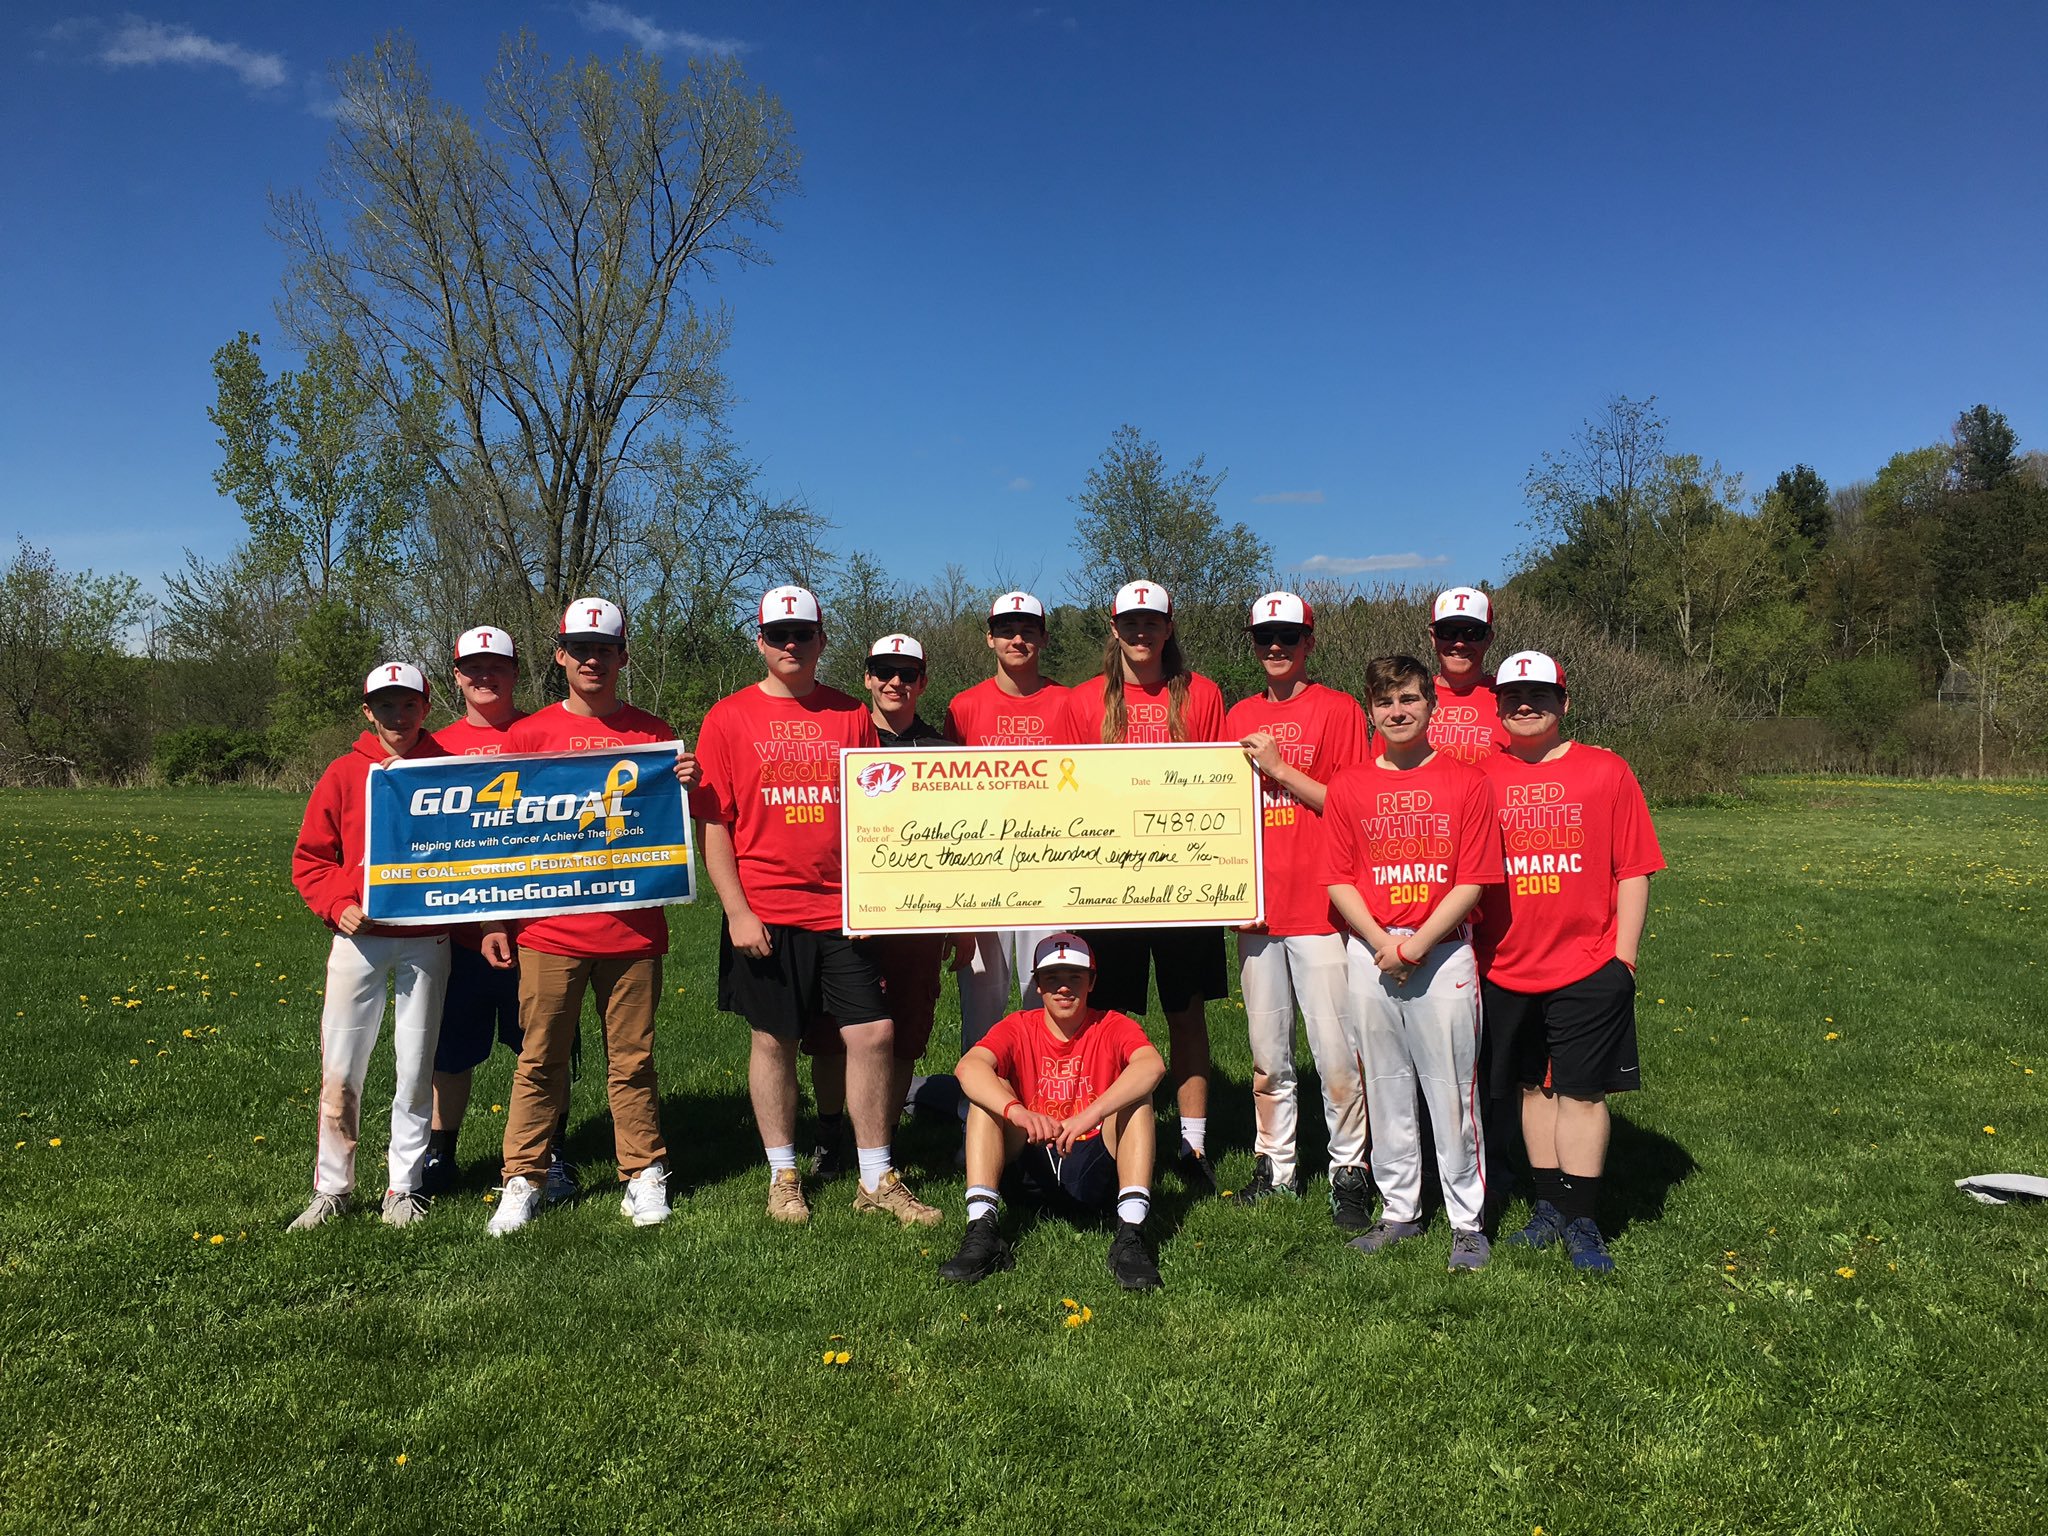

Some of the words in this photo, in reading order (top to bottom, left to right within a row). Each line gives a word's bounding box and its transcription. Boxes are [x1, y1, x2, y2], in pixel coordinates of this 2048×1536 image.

[782, 595, 797, 615] T
[1011, 596, 1025, 610] T
[1134, 587, 1149, 605] T
[1454, 593, 1470, 611] T
[586, 608, 602, 628] T
[1267, 599, 1282, 617] T
[477, 631, 492, 649] T
[890, 638, 905, 653] T
[385, 665, 402, 683] T
[1515, 659, 1531, 677] T
[770, 721, 822, 741] RED
[997, 716, 1044, 736] RED
[1426, 725, 1492, 747] HITE
[753, 741, 840, 762] WHITE
[911, 759, 1048, 779] TAMARAC
[1131, 777, 1150, 786] Date
[1164, 770, 1188, 786] May
[1209, 773, 1234, 783] 2019
[410, 786, 473, 816] GO
[476, 771, 522, 810] 4
[912, 781, 973, 791] BASEBALL
[976, 781, 985, 790] &
[988, 780, 1049, 790] SOFTBALL
[1506, 782, 1565, 807] RED
[1377, 790, 1432, 815] RED
[470, 809, 515, 828] THE
[785, 805, 825, 824] 2019
[1143, 812, 1226, 834] 7489.00
[1264, 807, 1295, 827] 2019
[856, 825, 872, 834] Pay
[882, 824, 894, 833] the
[900, 819, 988, 846] Go4theGoal
[999, 818, 1062, 841] Pediatric
[1067, 817, 1115, 837] Cancer
[1361, 814, 1450, 840] WHITE
[411, 841, 451, 851] Helping
[454, 839, 475, 849] Kids
[478, 837, 499, 847] with
[502, 835, 540, 845] Cancer
[542, 831, 584, 842] Achieve
[587, 829, 611, 839] Their
[614, 826, 644, 837] Goals
[856, 835, 880, 843] Order
[880, 835, 891, 843] of
[380, 868, 412, 880] ONE
[530, 855, 607, 870] PEDIATRIC
[611, 850, 670, 864] CANCER
[871, 844, 933, 869] Seven
[936, 846, 1004, 867] thousand
[1009, 844, 1040, 872] four
[1041, 843, 1103, 865] hundred
[1105, 849, 1148, 872] eighty
[1148, 847, 1179, 863] nine
[1218, 857, 1249, 865] Dollars
[1372, 863, 1448, 885] TAMARAC
[425, 879, 635, 907] Go4theGoal.org
[1067, 886, 1118, 906] Tamarac
[1121, 884, 1174, 904] Baseball
[1176, 885, 1193, 902] &
[1195, 882, 1248, 907] Softball
[1389, 884, 1429, 905] 2019
[1515, 875, 1560, 896] 2019
[858, 904, 887, 913] Memo
[895, 894, 942, 913] Helping
[945, 892, 977, 909] Kids
[980, 892, 1001, 908] with
[1005, 891, 1042, 907] Cancer
[1054, 941, 1070, 959] T
[1041, 1056, 1083, 1079] RED
